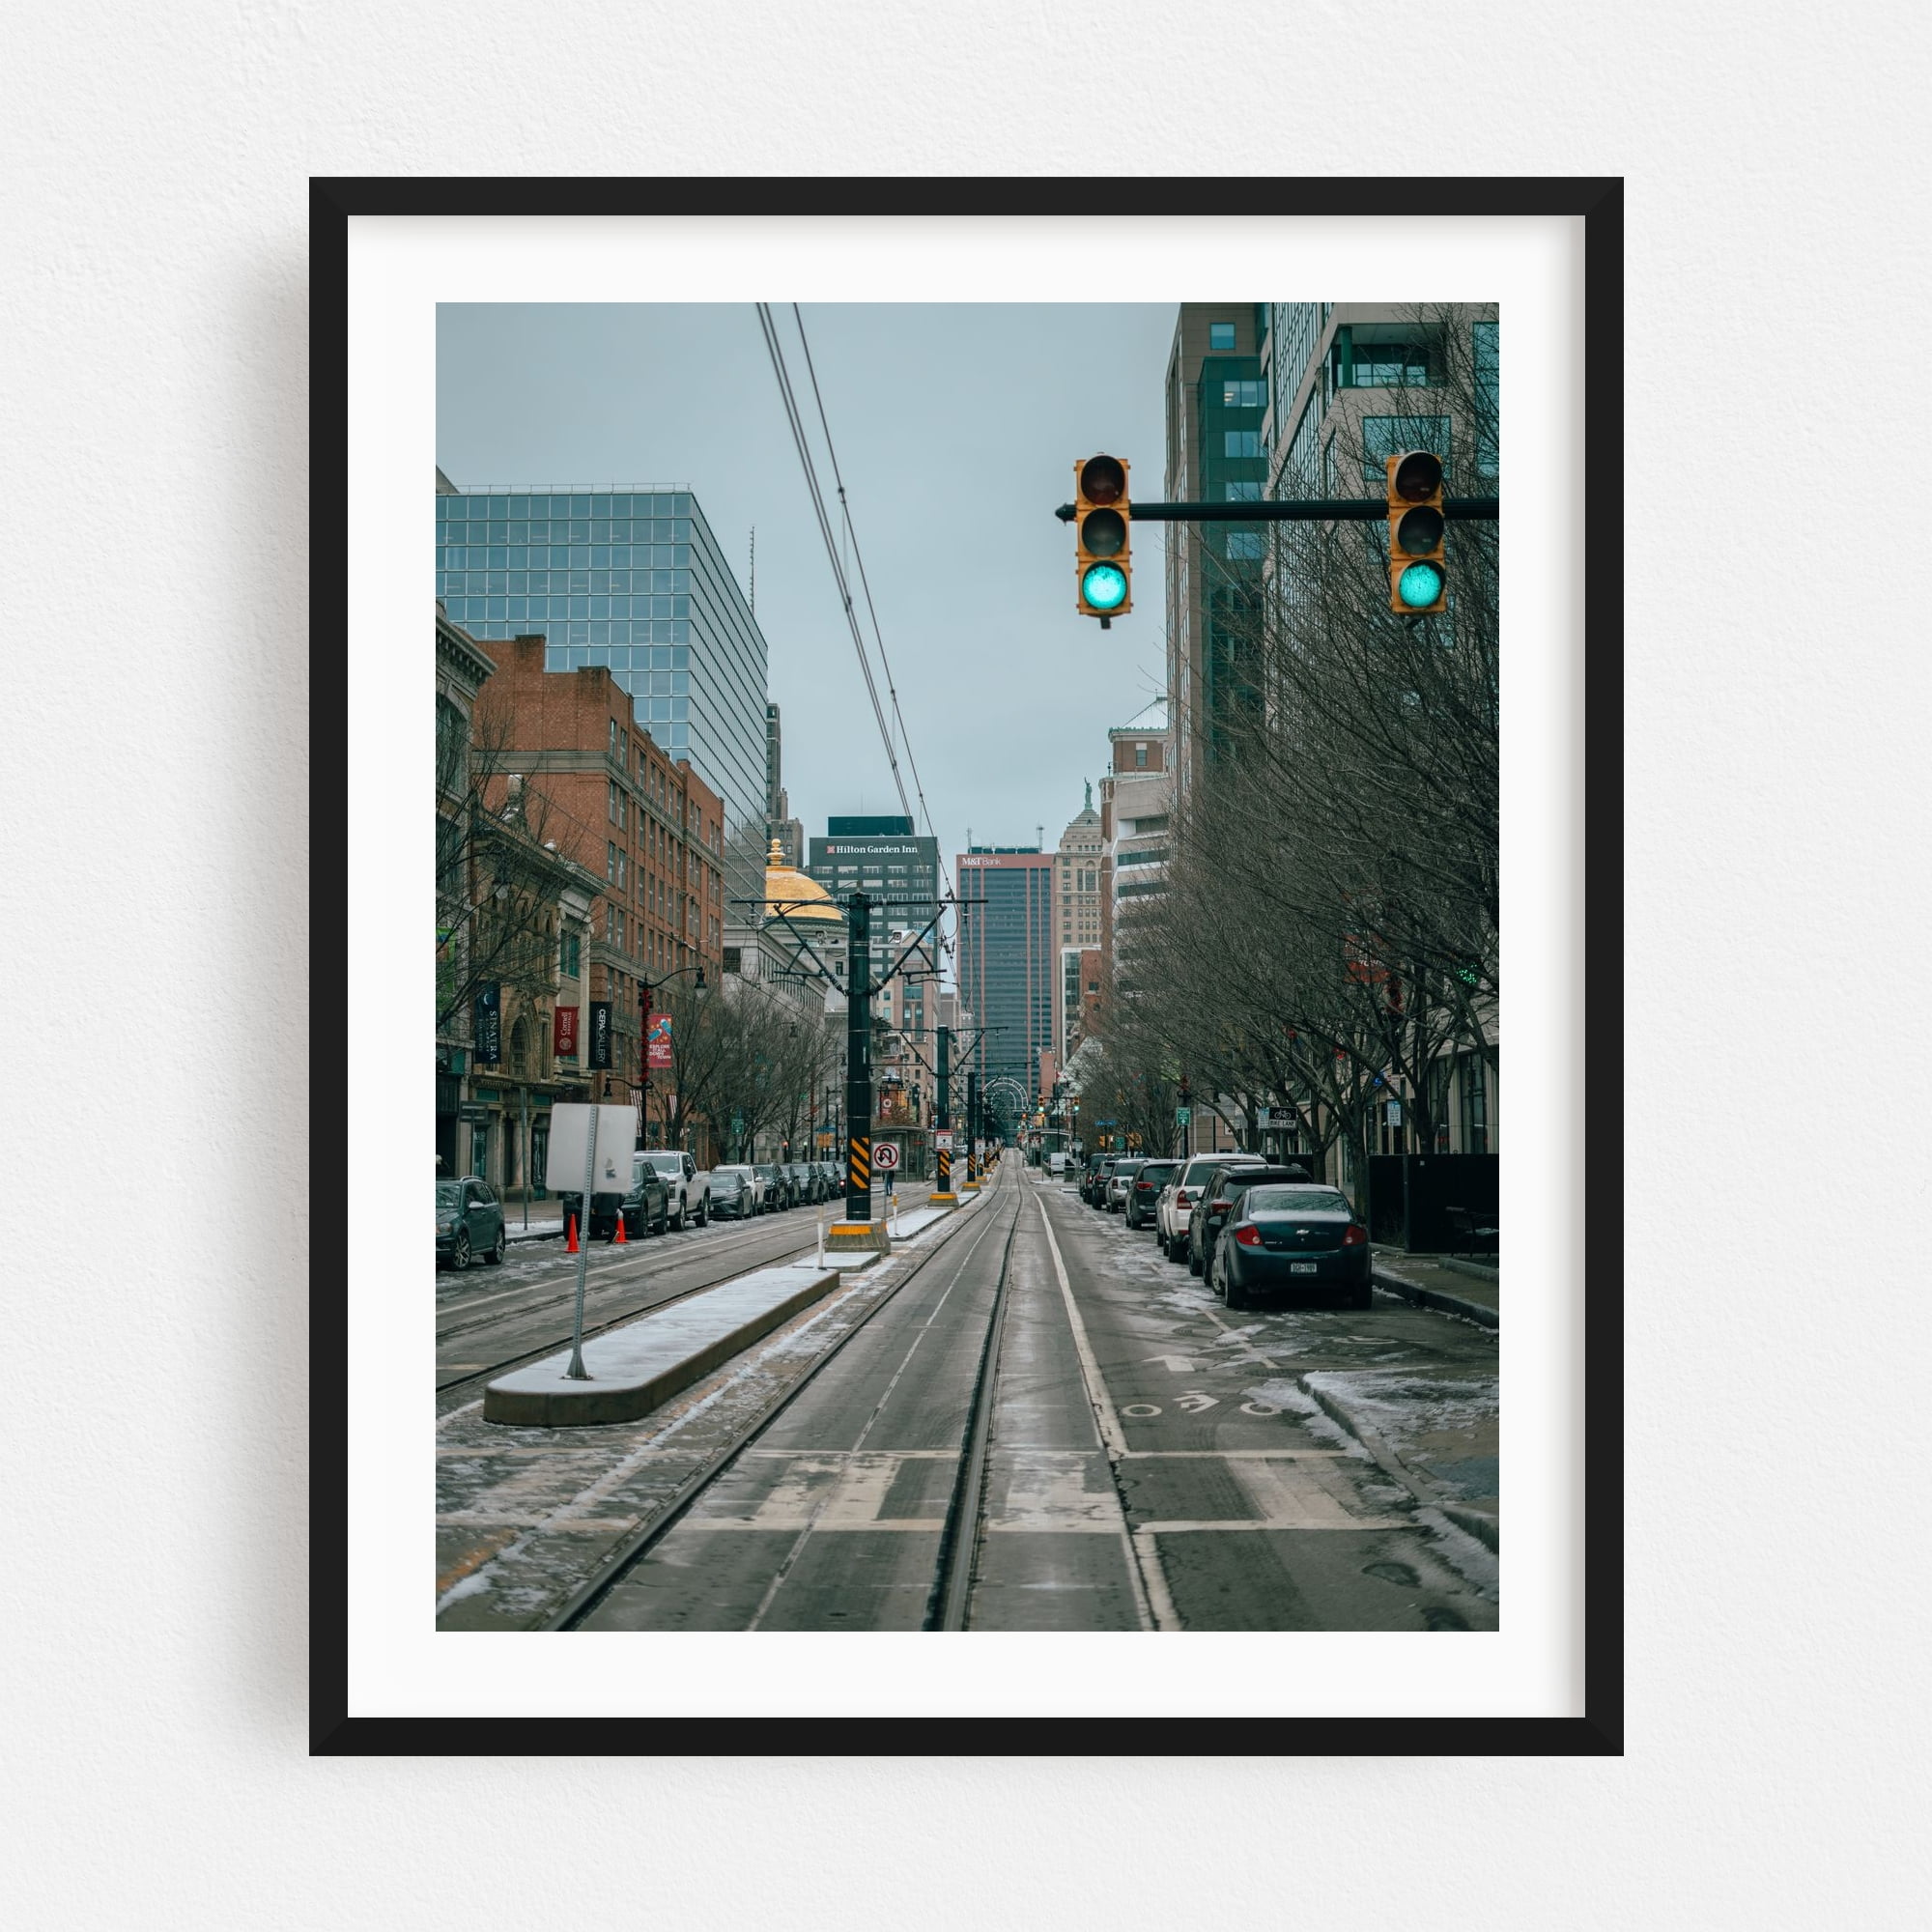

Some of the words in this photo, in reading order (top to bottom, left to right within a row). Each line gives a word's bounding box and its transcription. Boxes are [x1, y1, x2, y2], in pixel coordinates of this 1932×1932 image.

[837, 845, 866, 854] Hilton
[867, 845, 899, 854] Garden
[901, 845, 918, 854] Inn
[962, 857, 983, 866] M&T
[983, 857, 1001, 866] Bank
